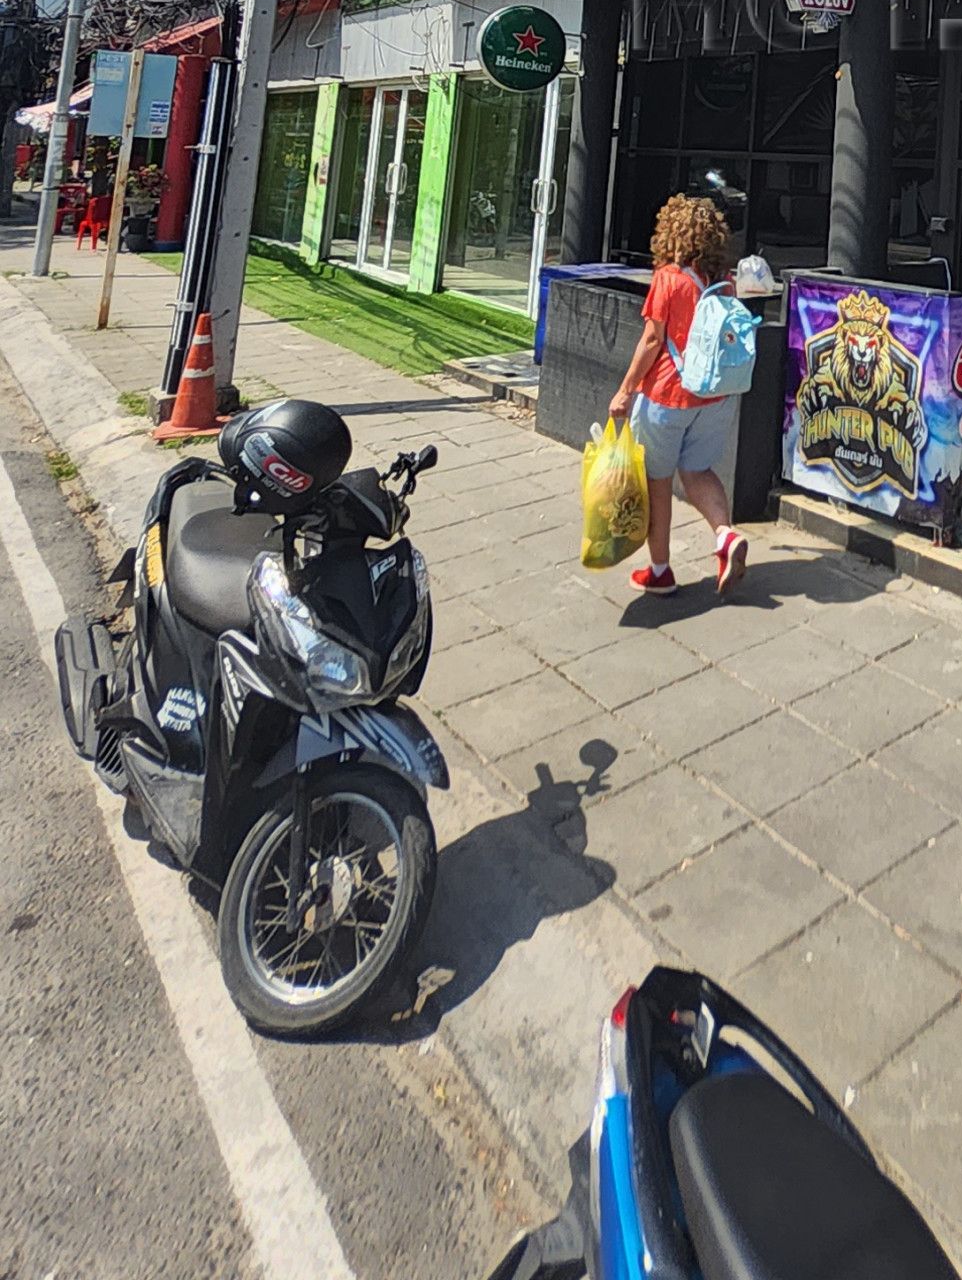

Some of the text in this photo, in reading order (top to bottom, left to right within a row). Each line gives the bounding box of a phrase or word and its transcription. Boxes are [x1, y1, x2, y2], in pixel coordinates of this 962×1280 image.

[495, 55, 552, 74] Heineken
[803, 405, 915, 481] HUNTER PUB
[268, 462, 305, 489] Cub
